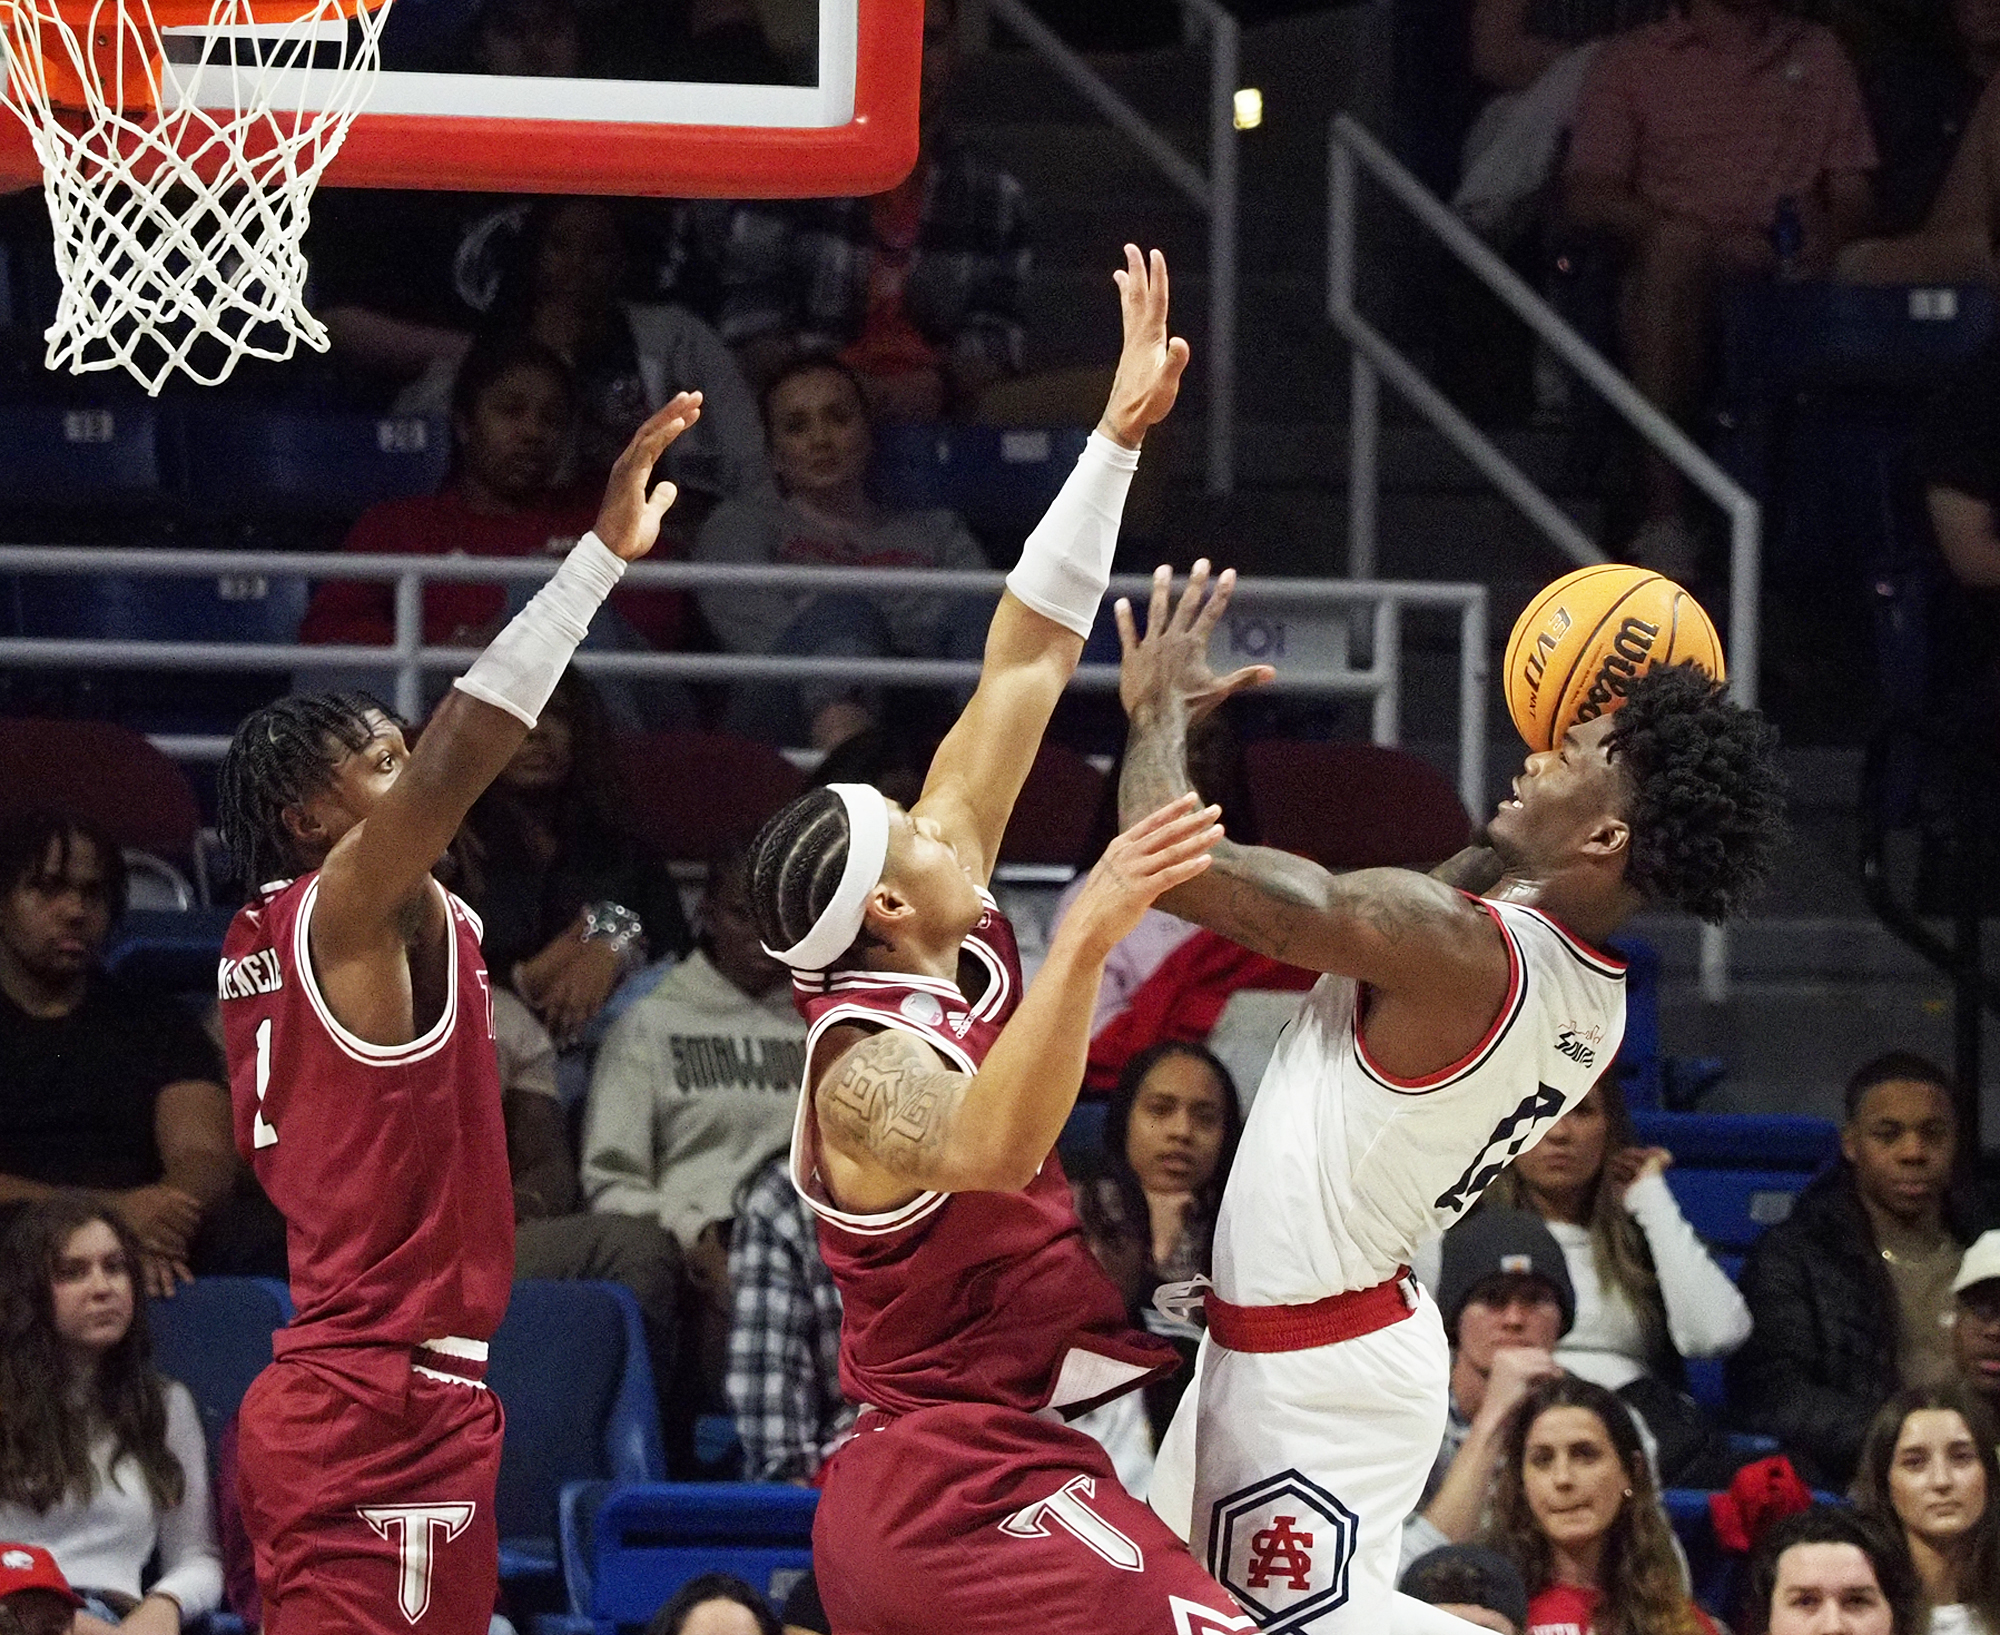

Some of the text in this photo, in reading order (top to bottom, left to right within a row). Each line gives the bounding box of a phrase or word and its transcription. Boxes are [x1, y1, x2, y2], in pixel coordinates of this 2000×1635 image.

[1524, 606, 1573, 692] EVO
[253, 1018, 279, 1150] 1
[355, 1501, 476, 1625] T
